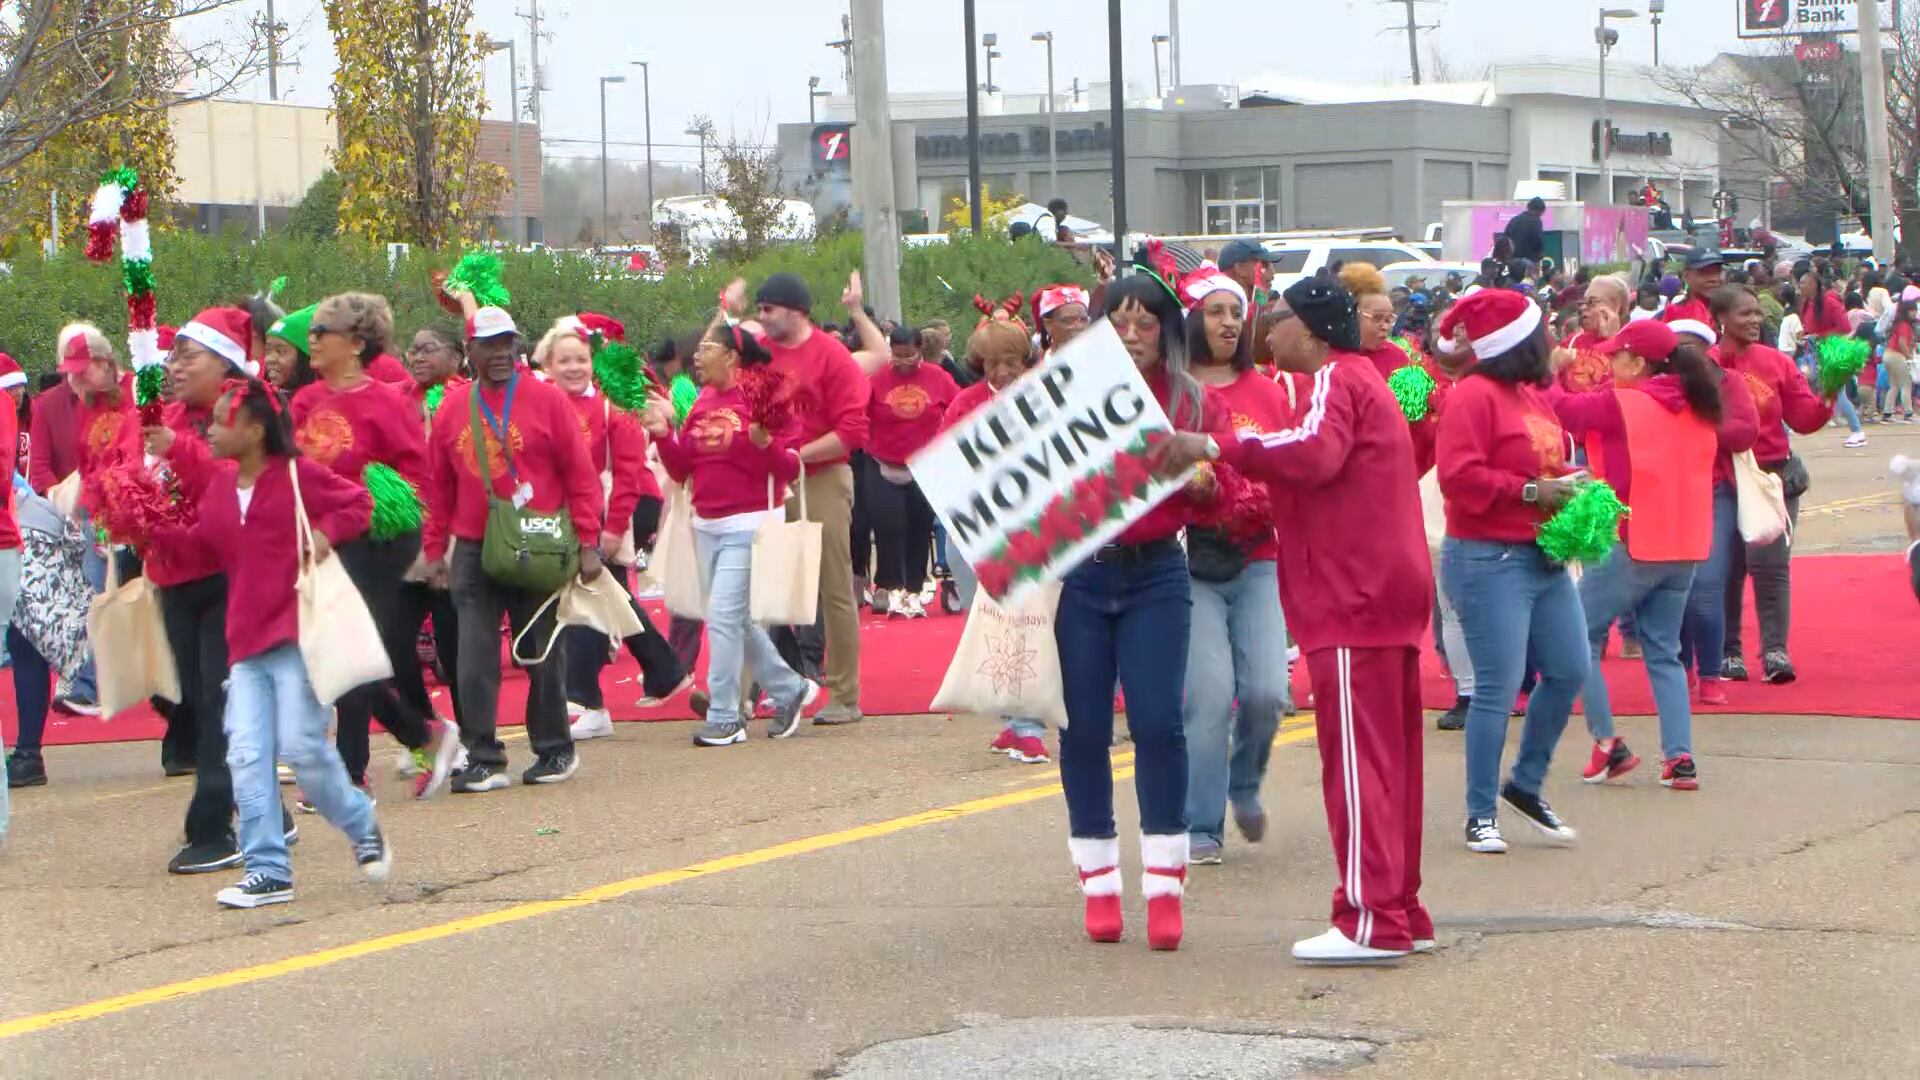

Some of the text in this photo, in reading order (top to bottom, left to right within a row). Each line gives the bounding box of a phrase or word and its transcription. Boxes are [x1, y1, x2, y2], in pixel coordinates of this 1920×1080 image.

[1797, 7, 1846, 23] Bank
[947, 383, 1145, 544] MOVING
[957, 362, 1073, 471] KEEP
